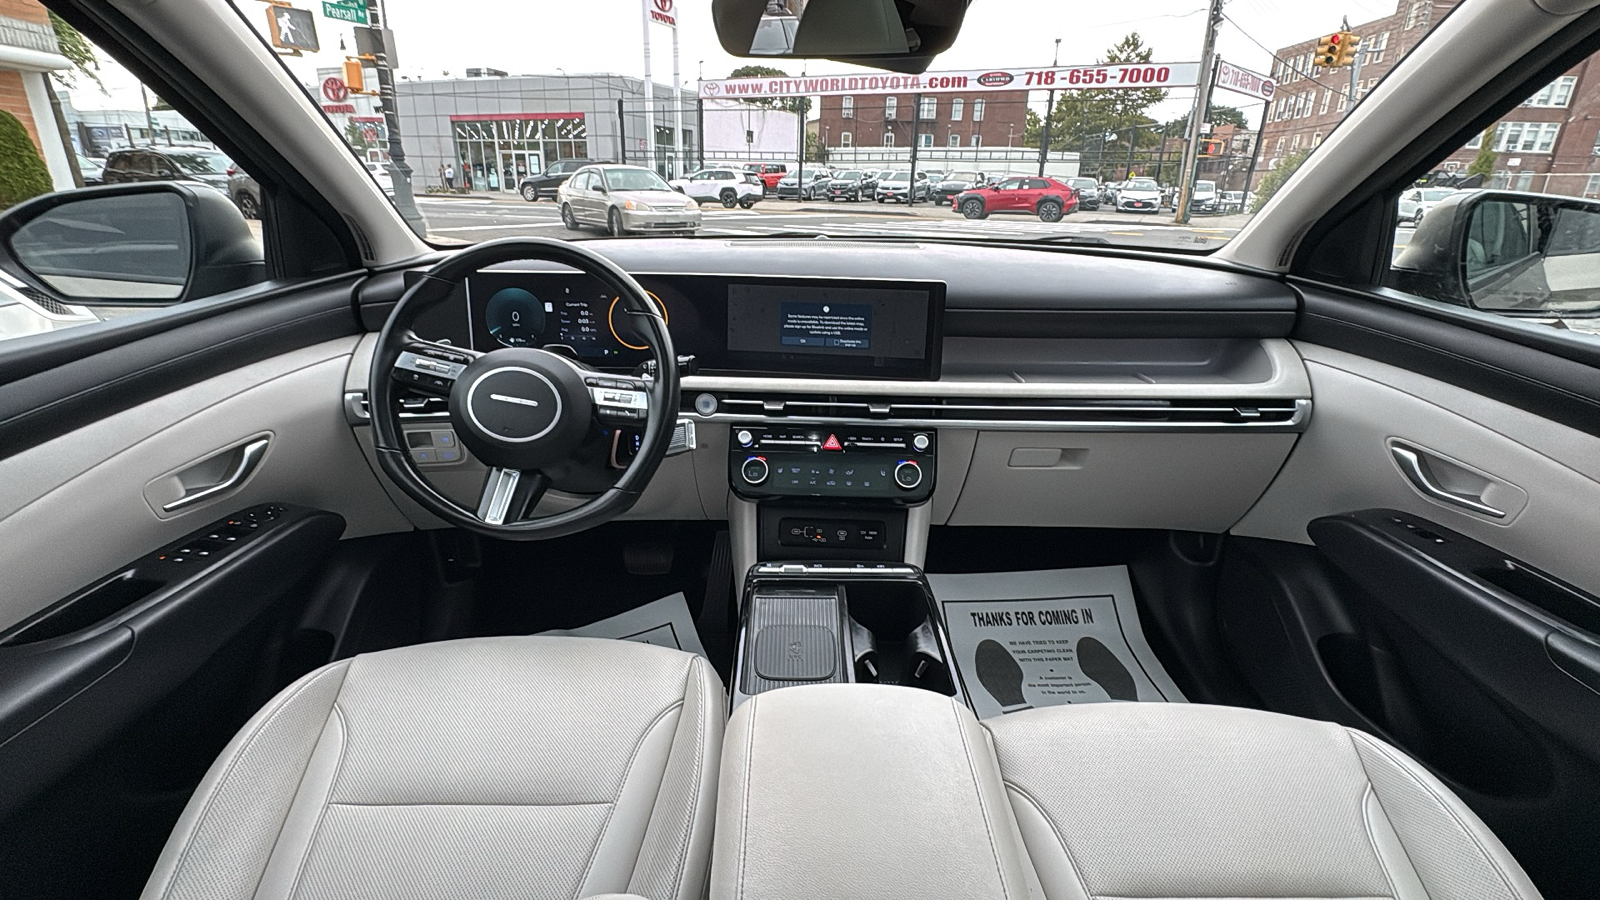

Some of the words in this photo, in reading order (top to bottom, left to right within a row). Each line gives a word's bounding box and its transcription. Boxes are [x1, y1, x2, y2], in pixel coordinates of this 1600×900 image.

[325, 3, 358, 22] Pearsall
[650, 10, 676, 26] TOYOTA
[1024, 67, 1170, 86] 718-655-7000
[512, 311, 520, 322] 0
[970, 612, 1013, 628] THANKS
[1014, 611, 1037, 626] FOR
[1038, 609, 1079, 626] COMING
[1081, 608, 1094, 624] IN
